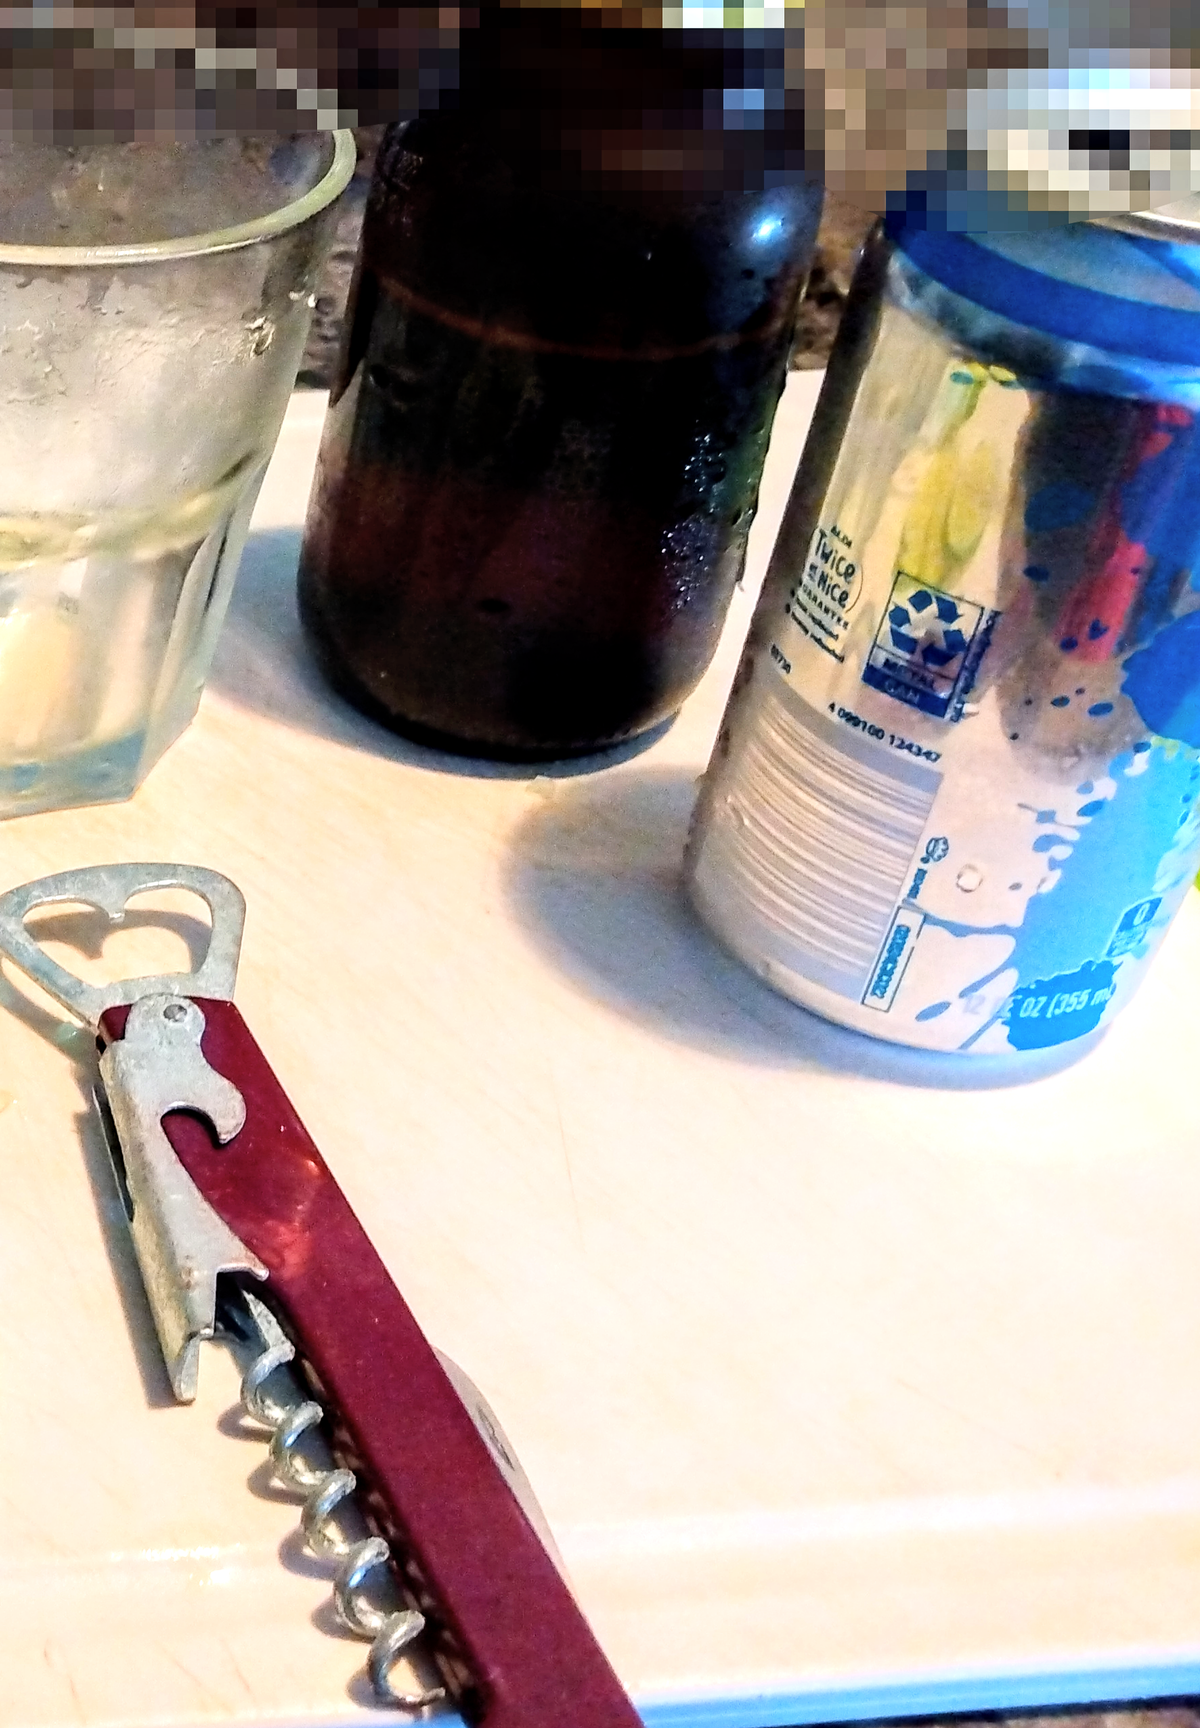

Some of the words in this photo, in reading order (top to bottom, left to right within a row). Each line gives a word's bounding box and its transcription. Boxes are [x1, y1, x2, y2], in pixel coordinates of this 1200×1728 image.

[818, 571, 849, 609] Nice
[828, 702, 836, 713] 4
[1019, 995, 1048, 1018] OZ
[1046, 988, 1092, 1018] (355
